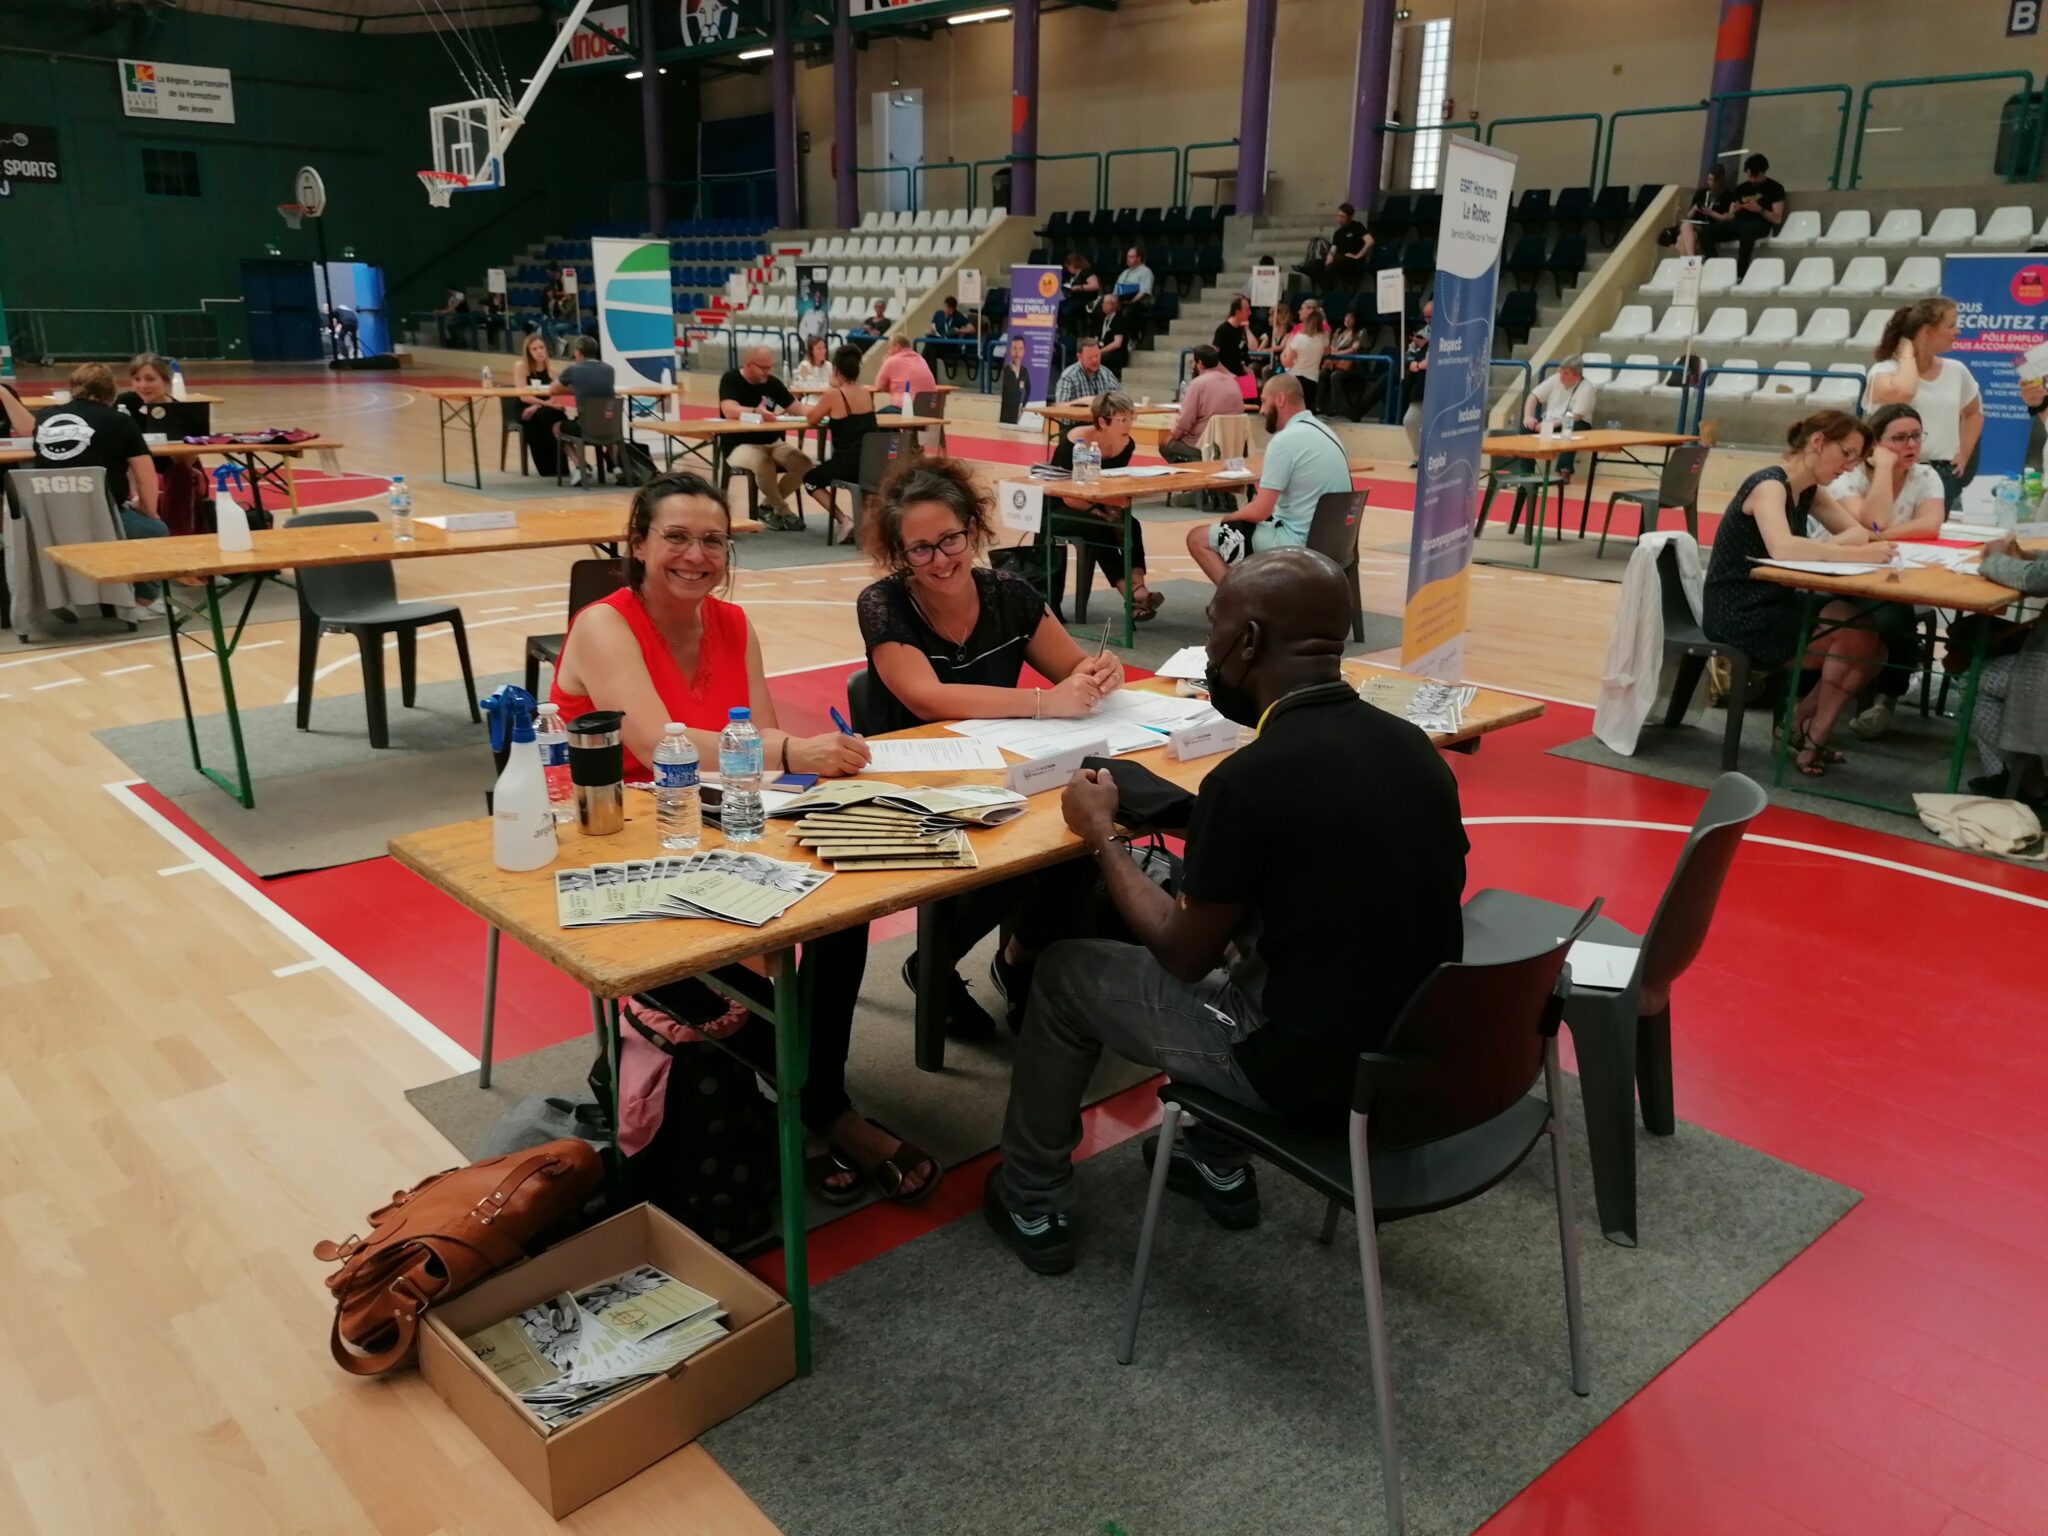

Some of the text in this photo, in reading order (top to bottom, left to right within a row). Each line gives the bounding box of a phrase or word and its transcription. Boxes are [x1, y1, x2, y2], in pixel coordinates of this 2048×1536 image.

[2012, 0, 2037, 31] B
[3, 159, 57, 178] SPORTS
[2022, 276, 2042, 285] LA
[1012, 304, 1024, 313] UN
[1024, 304, 1049, 313] EMPLOI
[1956, 302, 1984, 313] OUS
[1955, 313, 2036, 330] ECRUTEZ
[1981, 332, 2044, 343] PÔLE EMPLOI
[1952, 342, 2033, 351] OUS ACCOMPAG
[30, 475, 94, 495] RGIS
